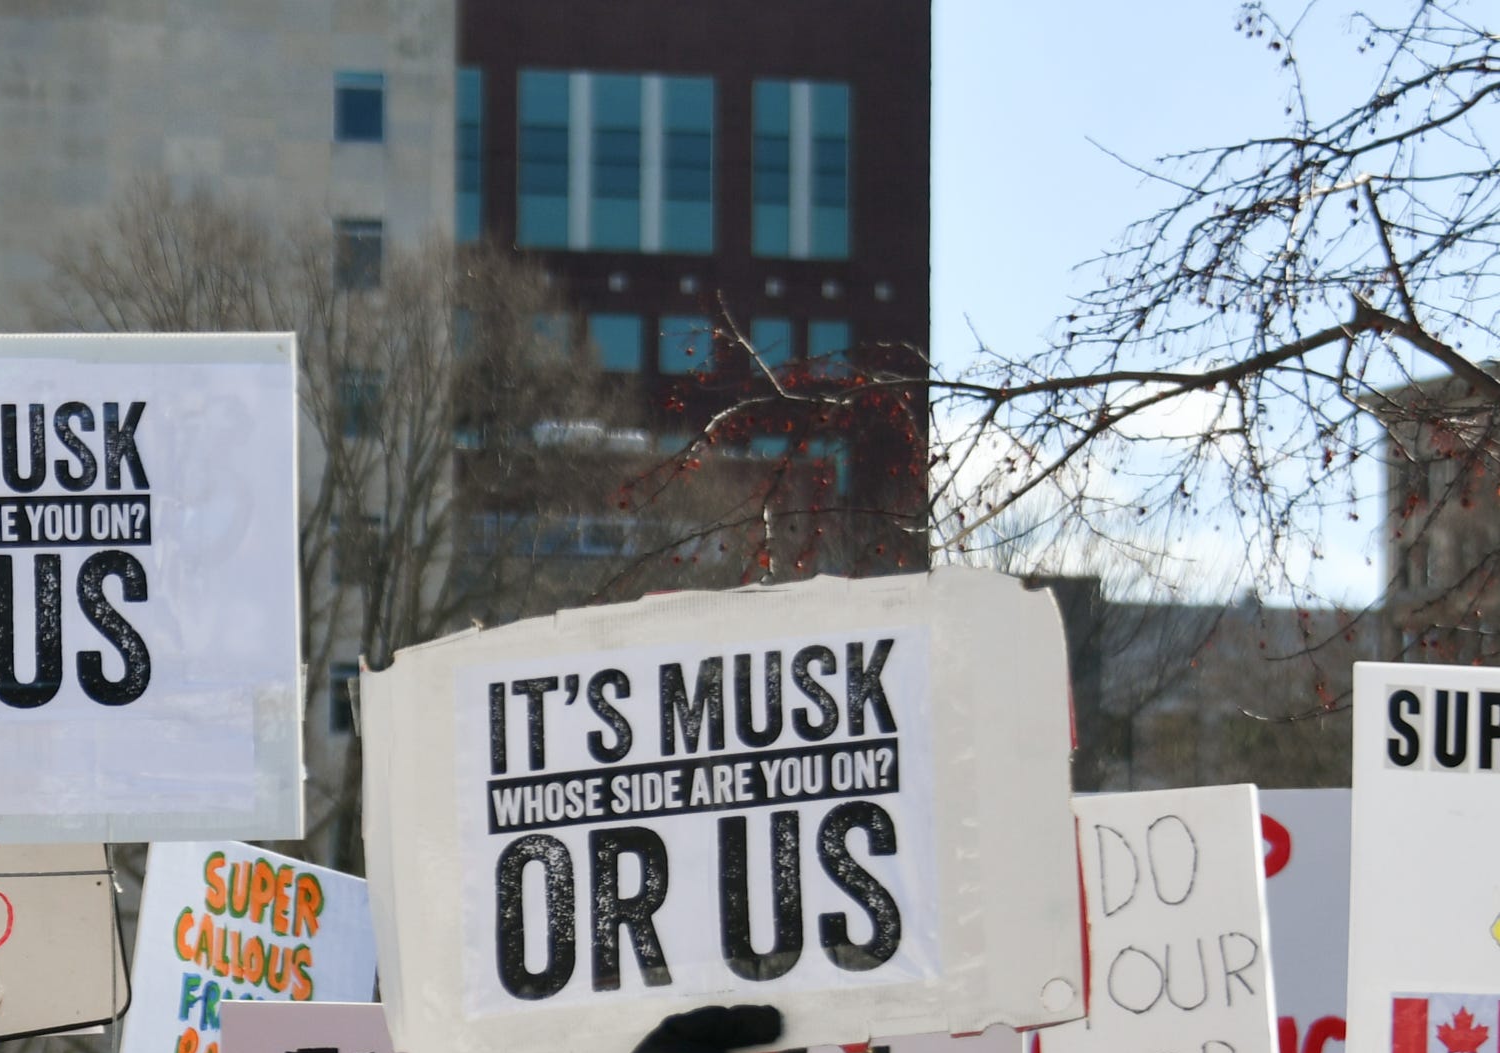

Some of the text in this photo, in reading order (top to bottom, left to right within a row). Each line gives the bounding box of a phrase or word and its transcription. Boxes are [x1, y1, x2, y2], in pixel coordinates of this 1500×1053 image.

[25, 504, 84, 541] YOU
[90, 503, 144, 540] ON?
[488, 638, 898, 775] IT'S MUSK
[492, 747, 892, 827] WHOSE SIDE ARE YOU ON?
[204, 851, 324, 938] SUPER
[495, 800, 902, 1000] OR US
[1095, 814, 1198, 916] DO
[173, 906, 313, 1001] CALLOUS
[1106, 931, 1259, 1014] OUR
